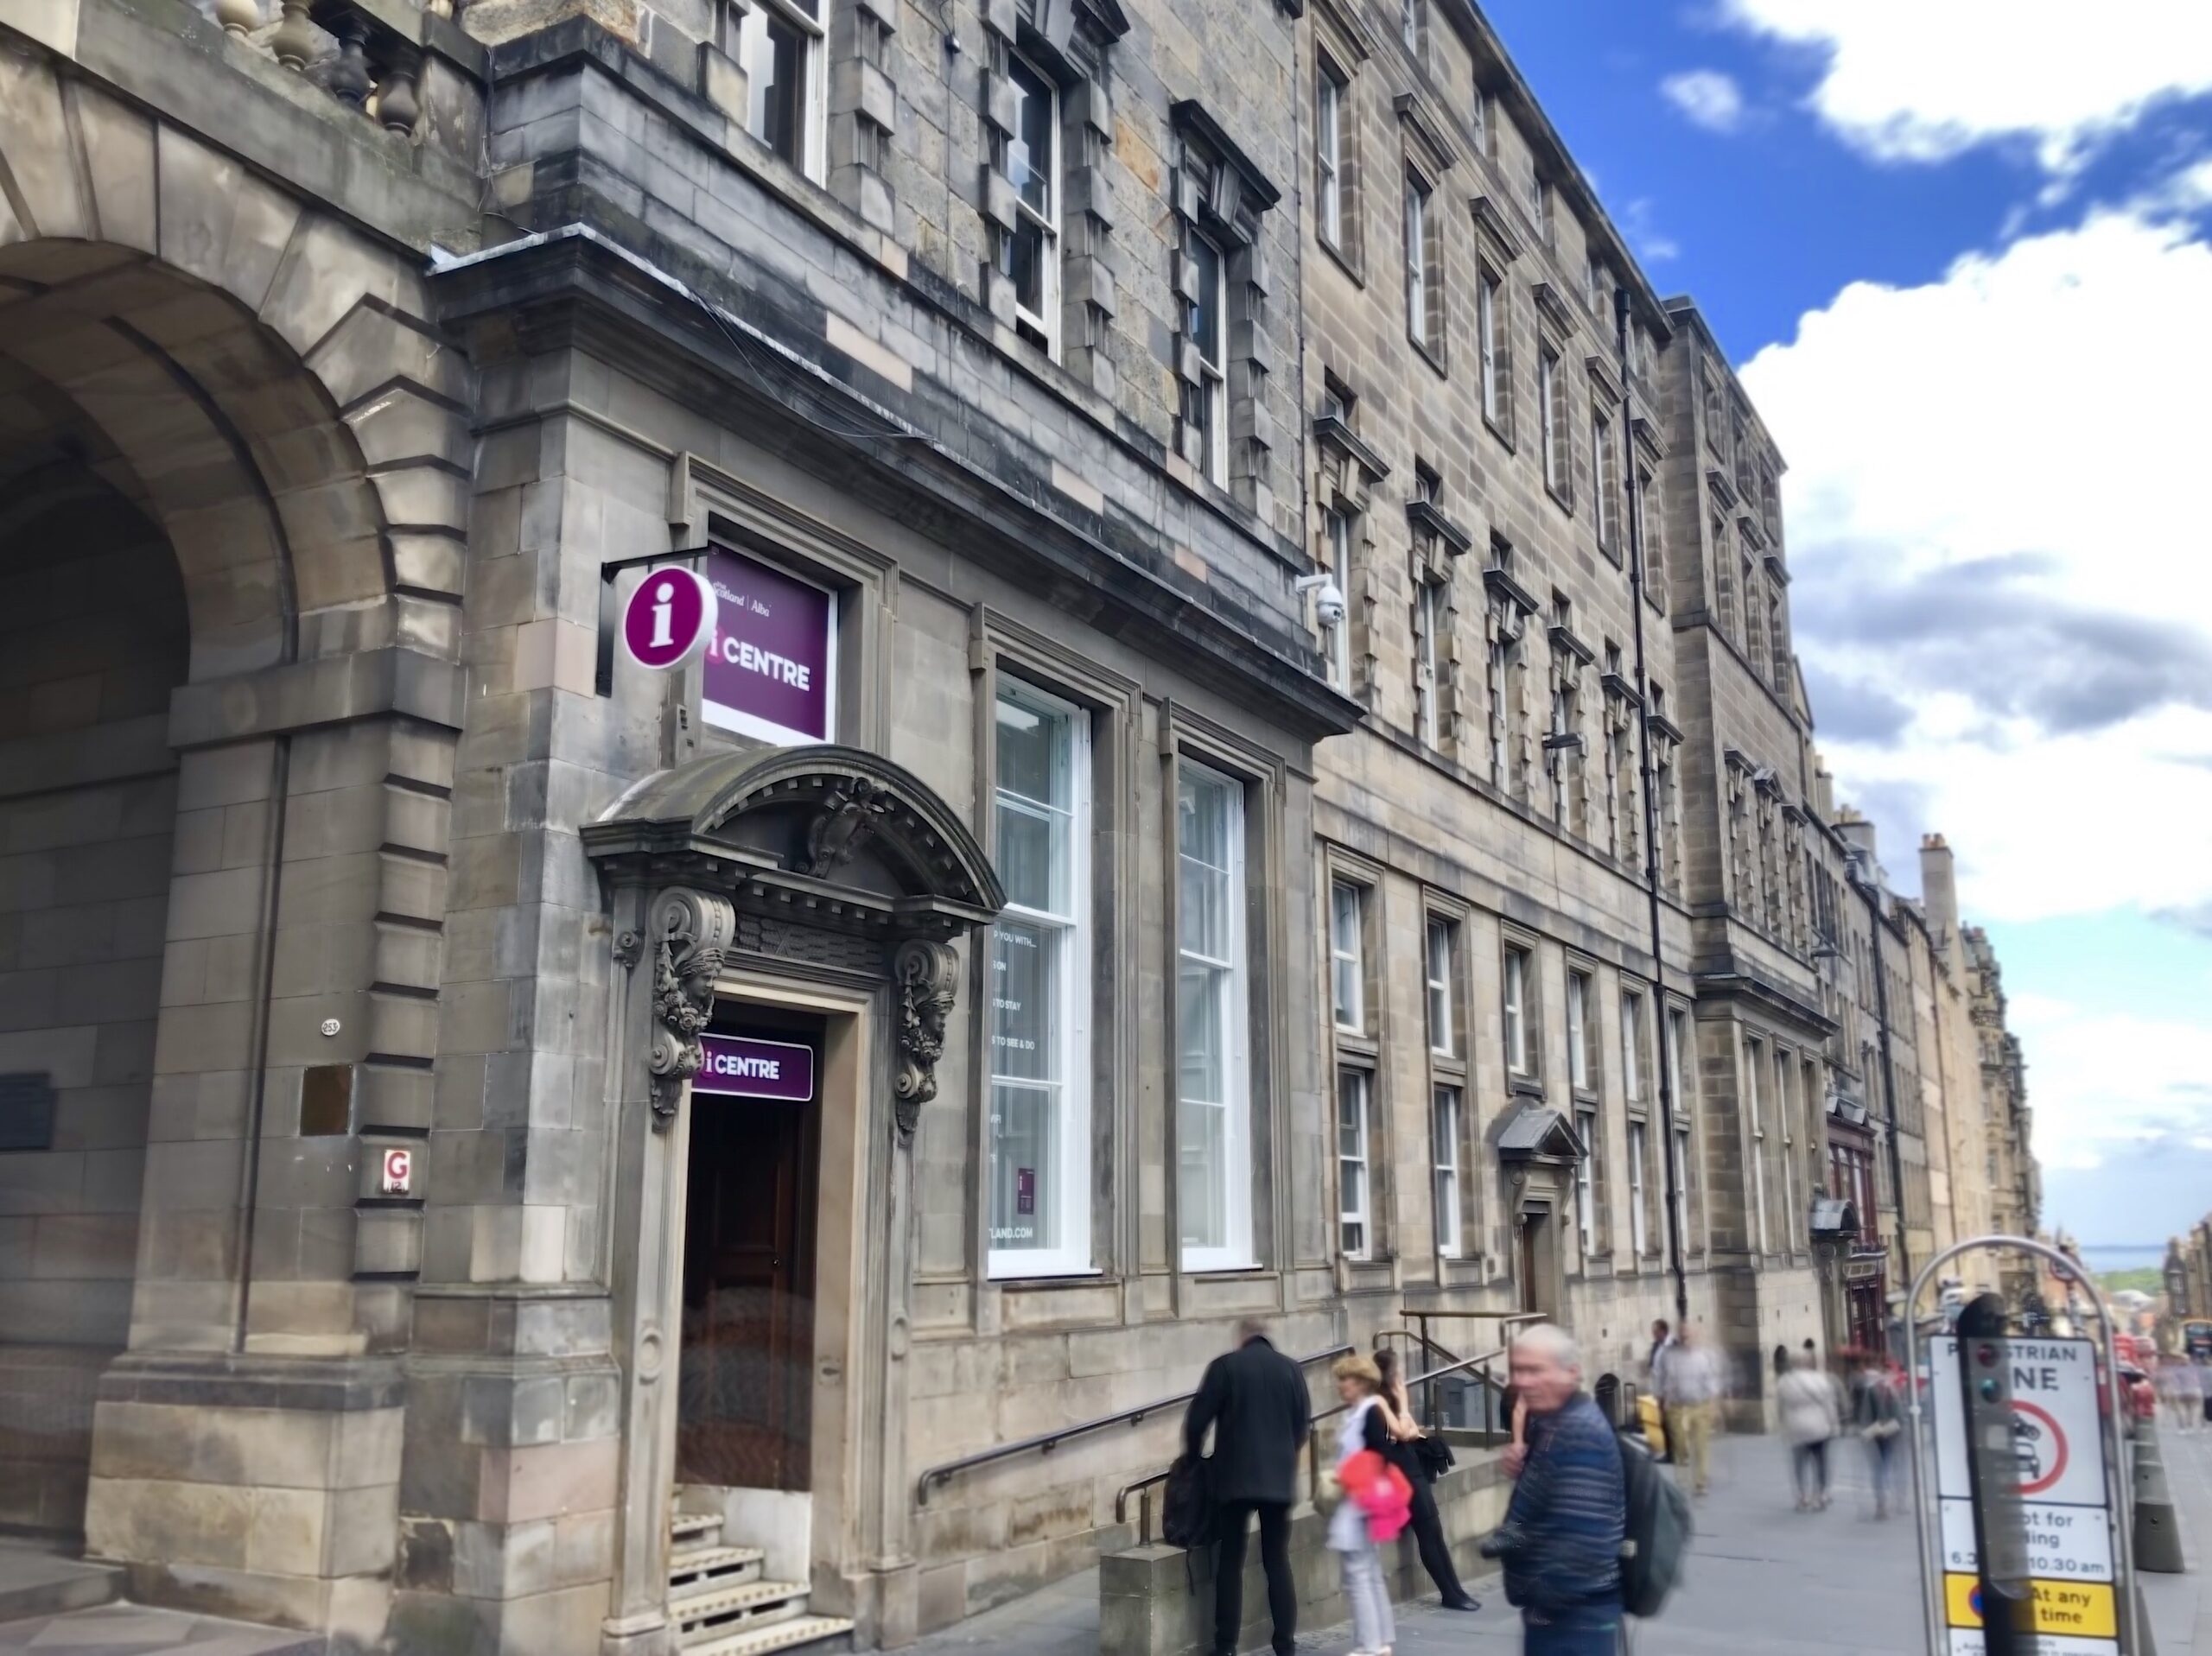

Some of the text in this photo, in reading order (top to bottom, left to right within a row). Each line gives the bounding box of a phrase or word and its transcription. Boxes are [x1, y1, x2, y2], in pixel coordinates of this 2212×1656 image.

[649, 582, 674, 648] i
[751, 600, 770, 618] Alba
[723, 637, 810, 692] CENTRE
[999, 930, 1014, 942] YOU
[995, 999, 1005, 1008] TO
[1005, 1000, 1021, 1012] STAY
[996, 1036, 1006, 1046] TO
[1007, 1037, 1018, 1048] SEE
[1025, 1040, 1035, 1050] DO
[715, 1054, 780, 1080] CENTRE
[387, 1152, 407, 1179] G
[2014, 1367, 2060, 1391] NE
[2046, 1512, 2073, 1527] for
[2032, 1587, 2092, 1608] At any
[2040, 1608, 2083, 1624] time
